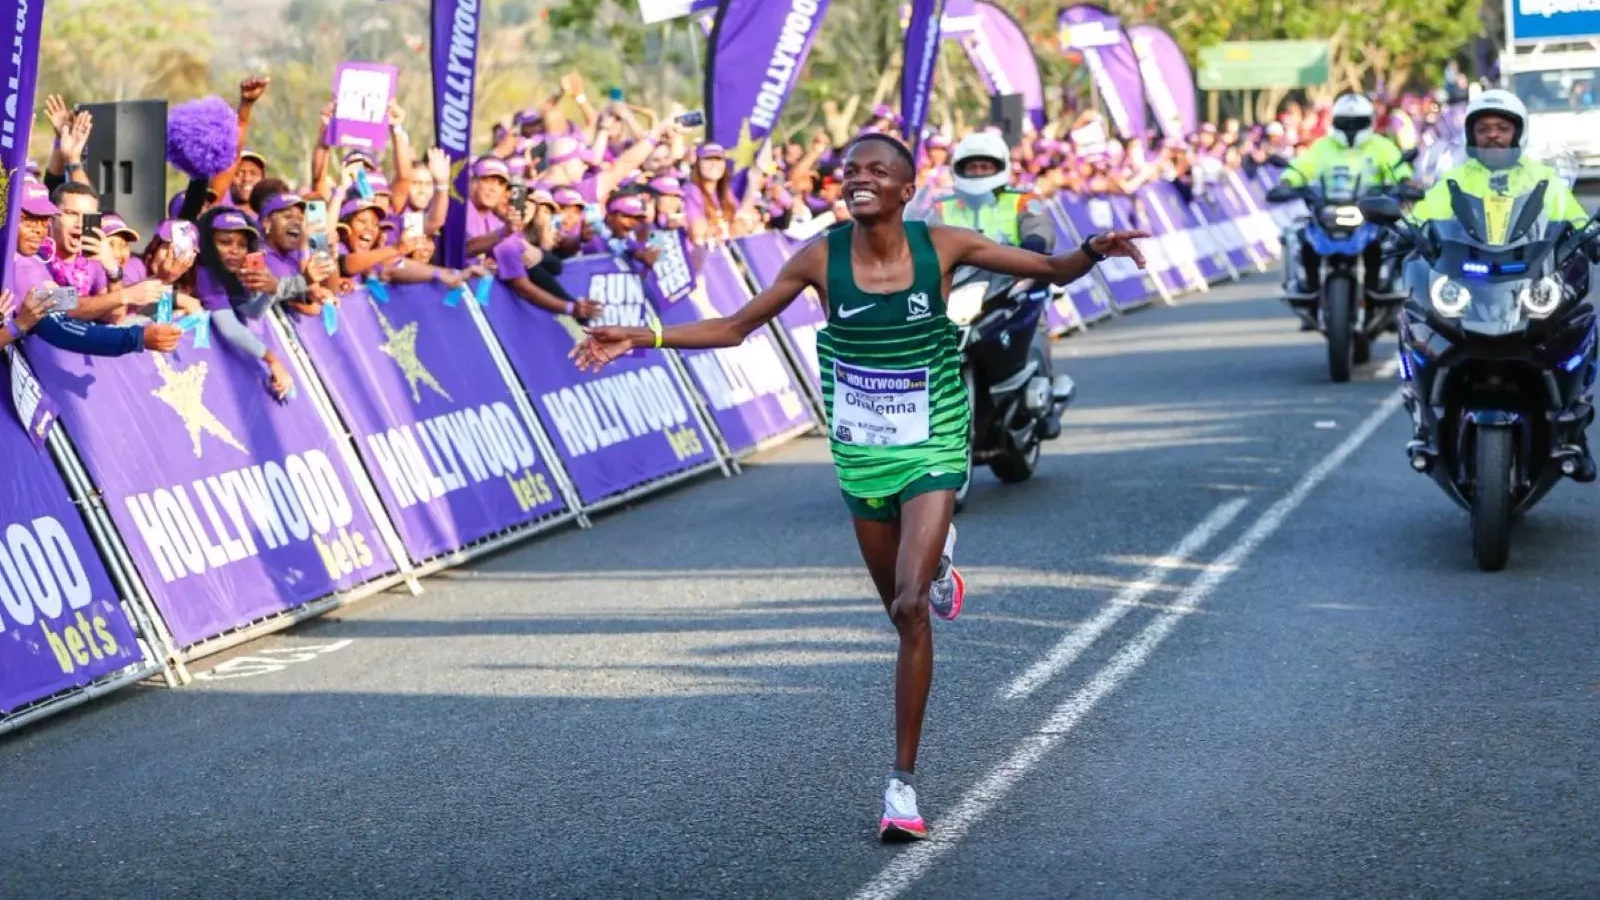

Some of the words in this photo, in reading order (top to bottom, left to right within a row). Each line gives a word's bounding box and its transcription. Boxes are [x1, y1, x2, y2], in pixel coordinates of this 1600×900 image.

[588, 272, 645, 304] RUN
[588, 304, 645, 328] OW.
[847, 372, 910, 390] HOLLYWOOD
[541, 365, 688, 457] HOLLYWOOD
[367, 401, 535, 509] HOLLYWOOD
[662, 424, 704, 461] bets
[505, 467, 553, 512] bets
[125, 449, 352, 583] HOLLYWOOD
[312, 528, 373, 580] bets
[39, 611, 118, 673] bets
